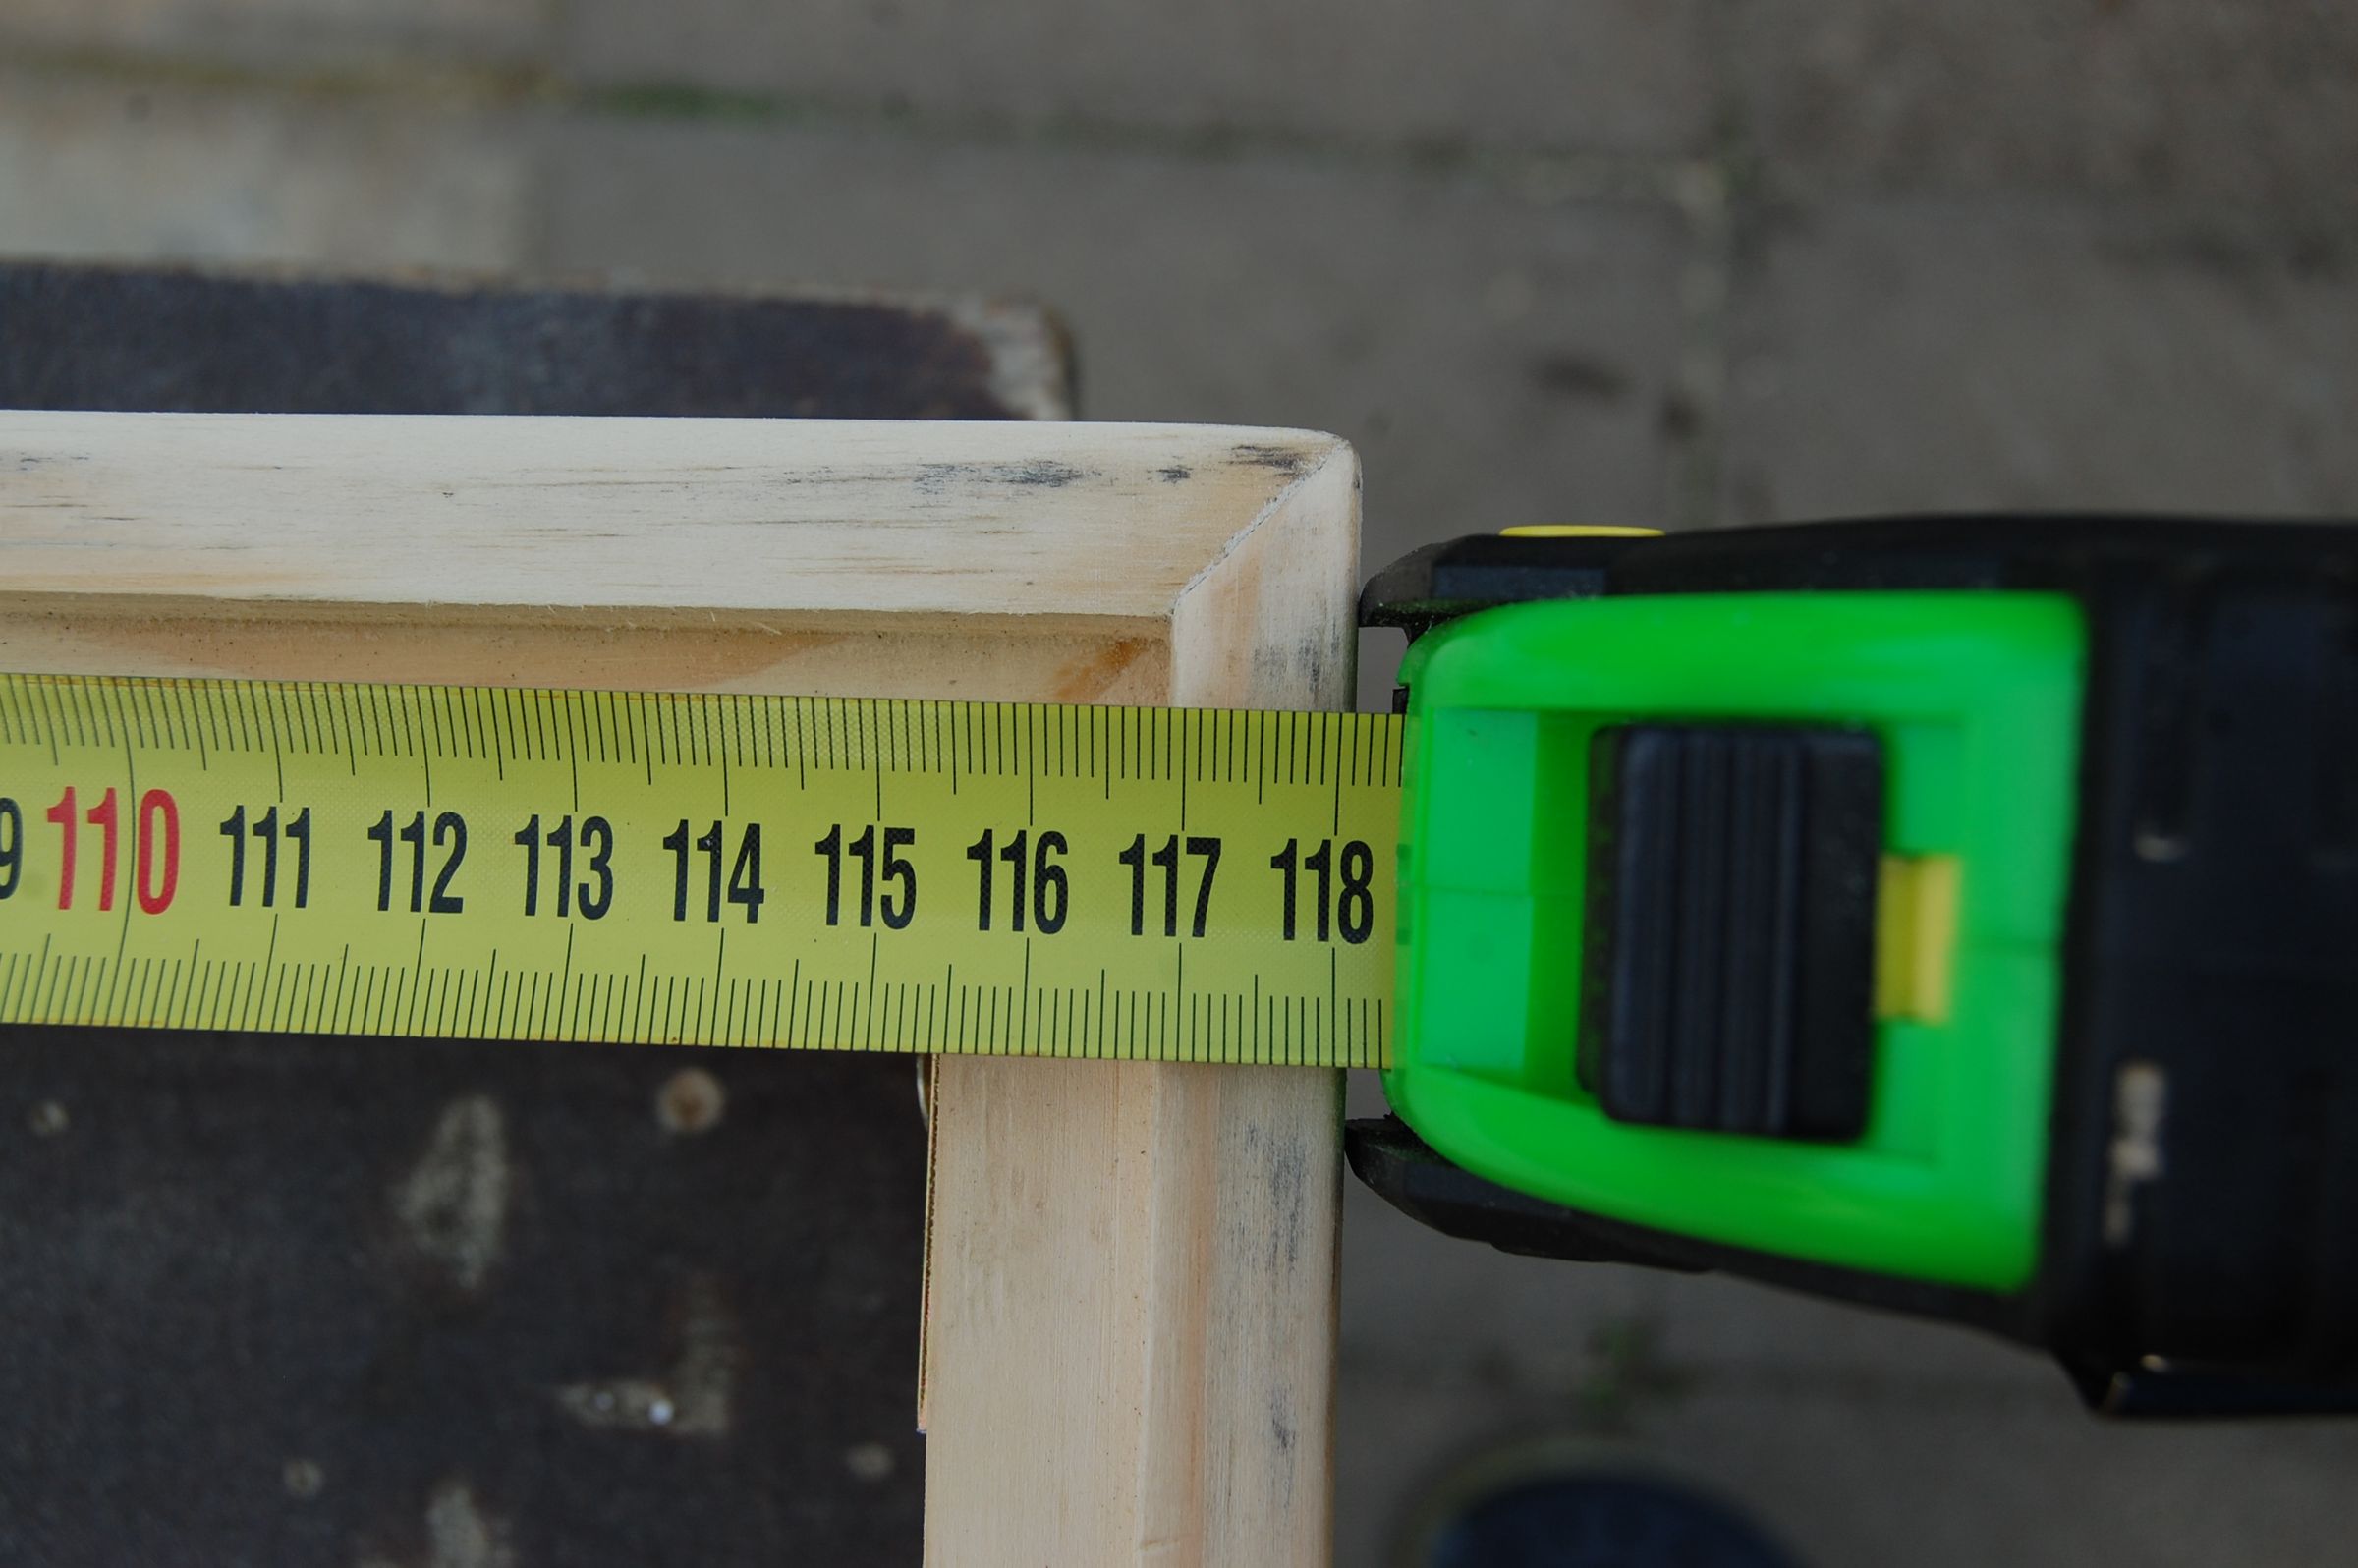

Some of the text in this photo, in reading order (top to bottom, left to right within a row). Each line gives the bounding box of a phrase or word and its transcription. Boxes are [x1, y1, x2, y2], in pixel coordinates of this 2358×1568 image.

[47, 786, 180, 915] 110
[219, 805, 310, 909] 111
[367, 810, 468, 914] 112
[514, 813, 614, 921] 113
[662, 818, 765, 924] 114
[814, 823, 917, 930] 115
[966, 828, 1069, 935] 116
[1118, 833, 1222, 938] 117
[1269, 837, 1375, 945] 118
